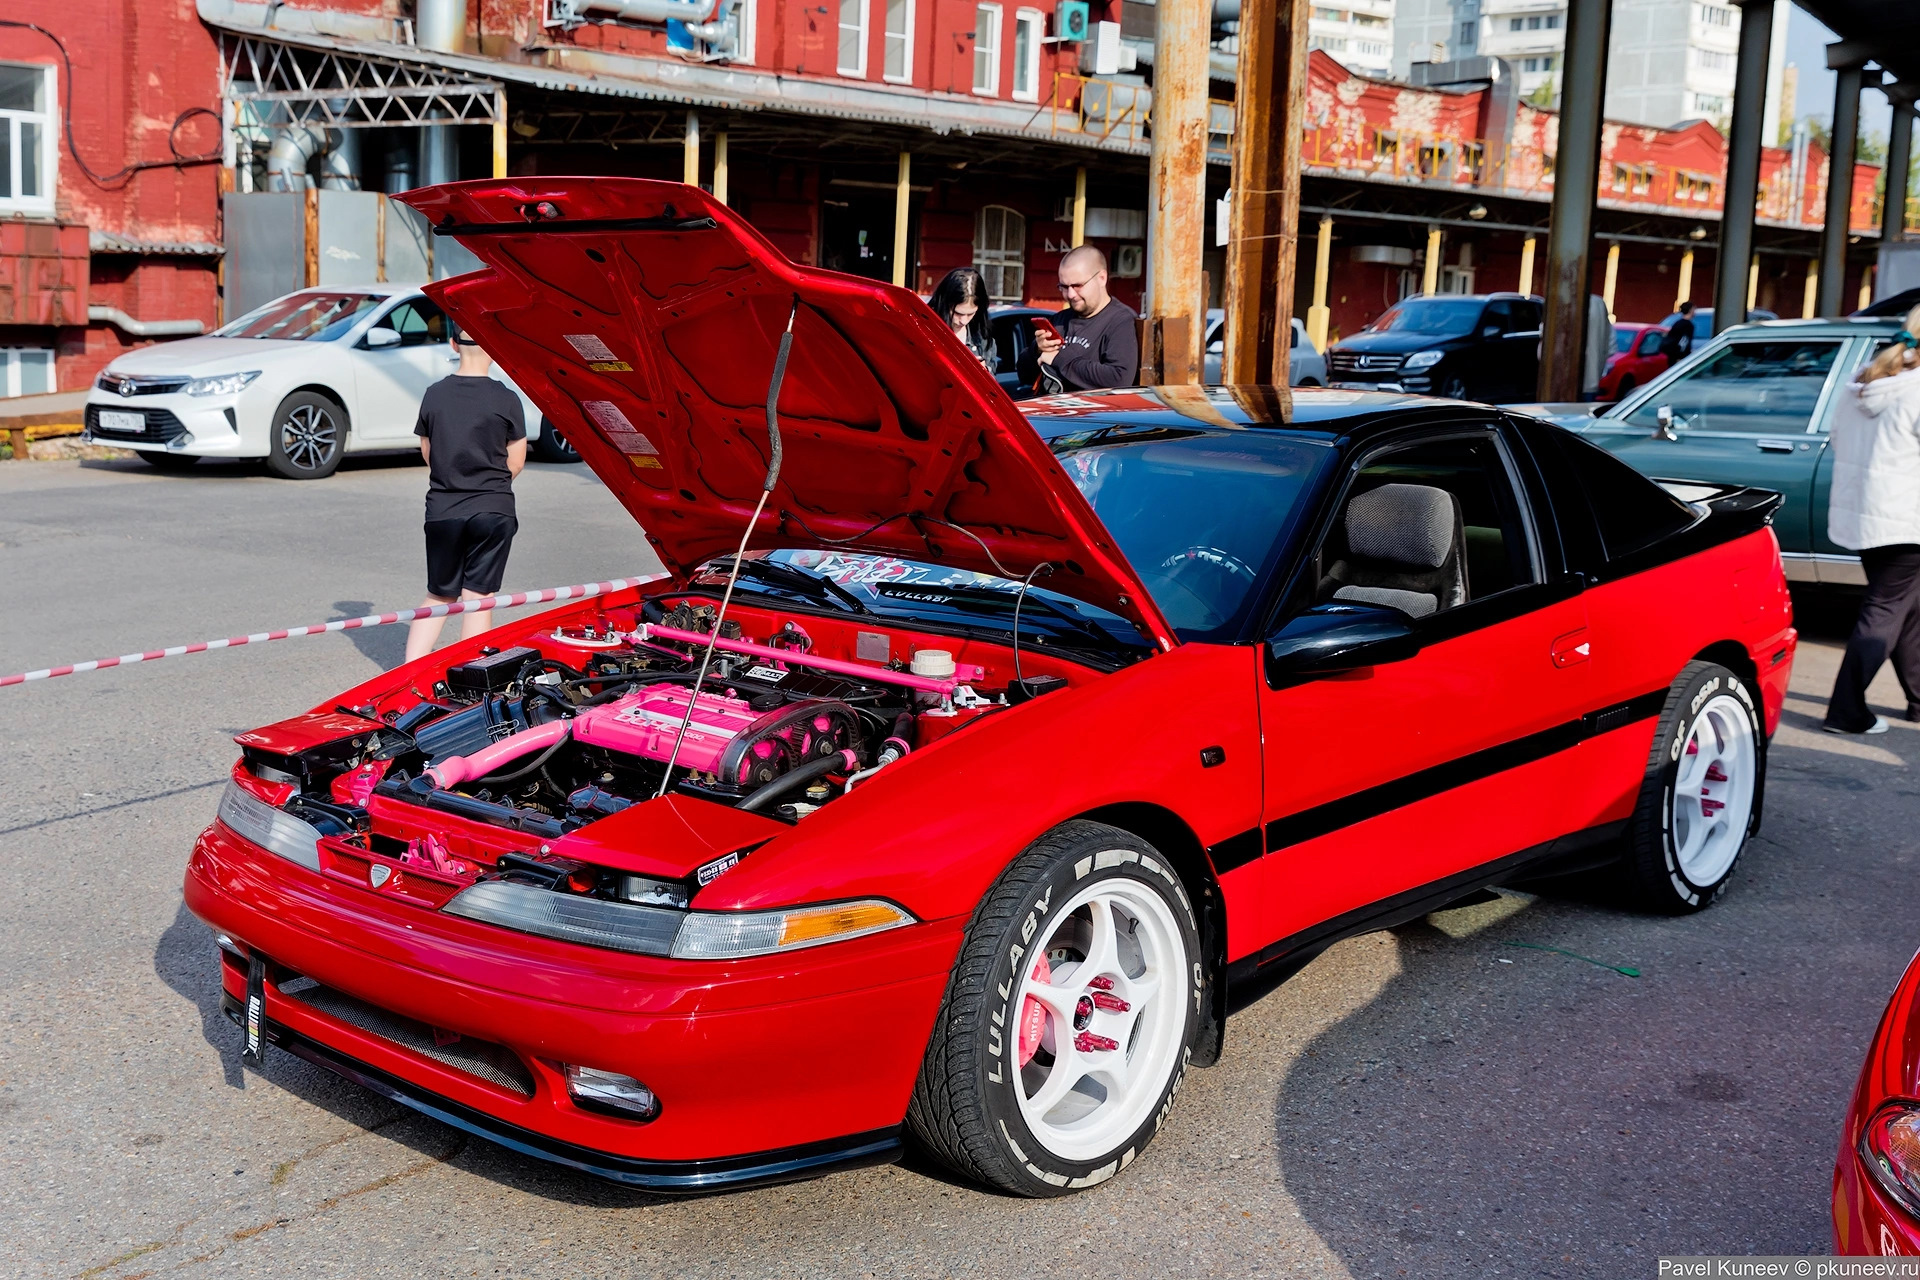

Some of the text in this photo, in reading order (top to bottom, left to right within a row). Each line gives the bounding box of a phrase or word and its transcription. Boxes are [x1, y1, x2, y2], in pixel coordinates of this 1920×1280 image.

[885, 589, 953, 604] LULLABY
[1690, 676, 1720, 715] DSM
[988, 885, 1053, 1084] LULLABY
[1030, 1001, 1042, 1042] MITSUB
